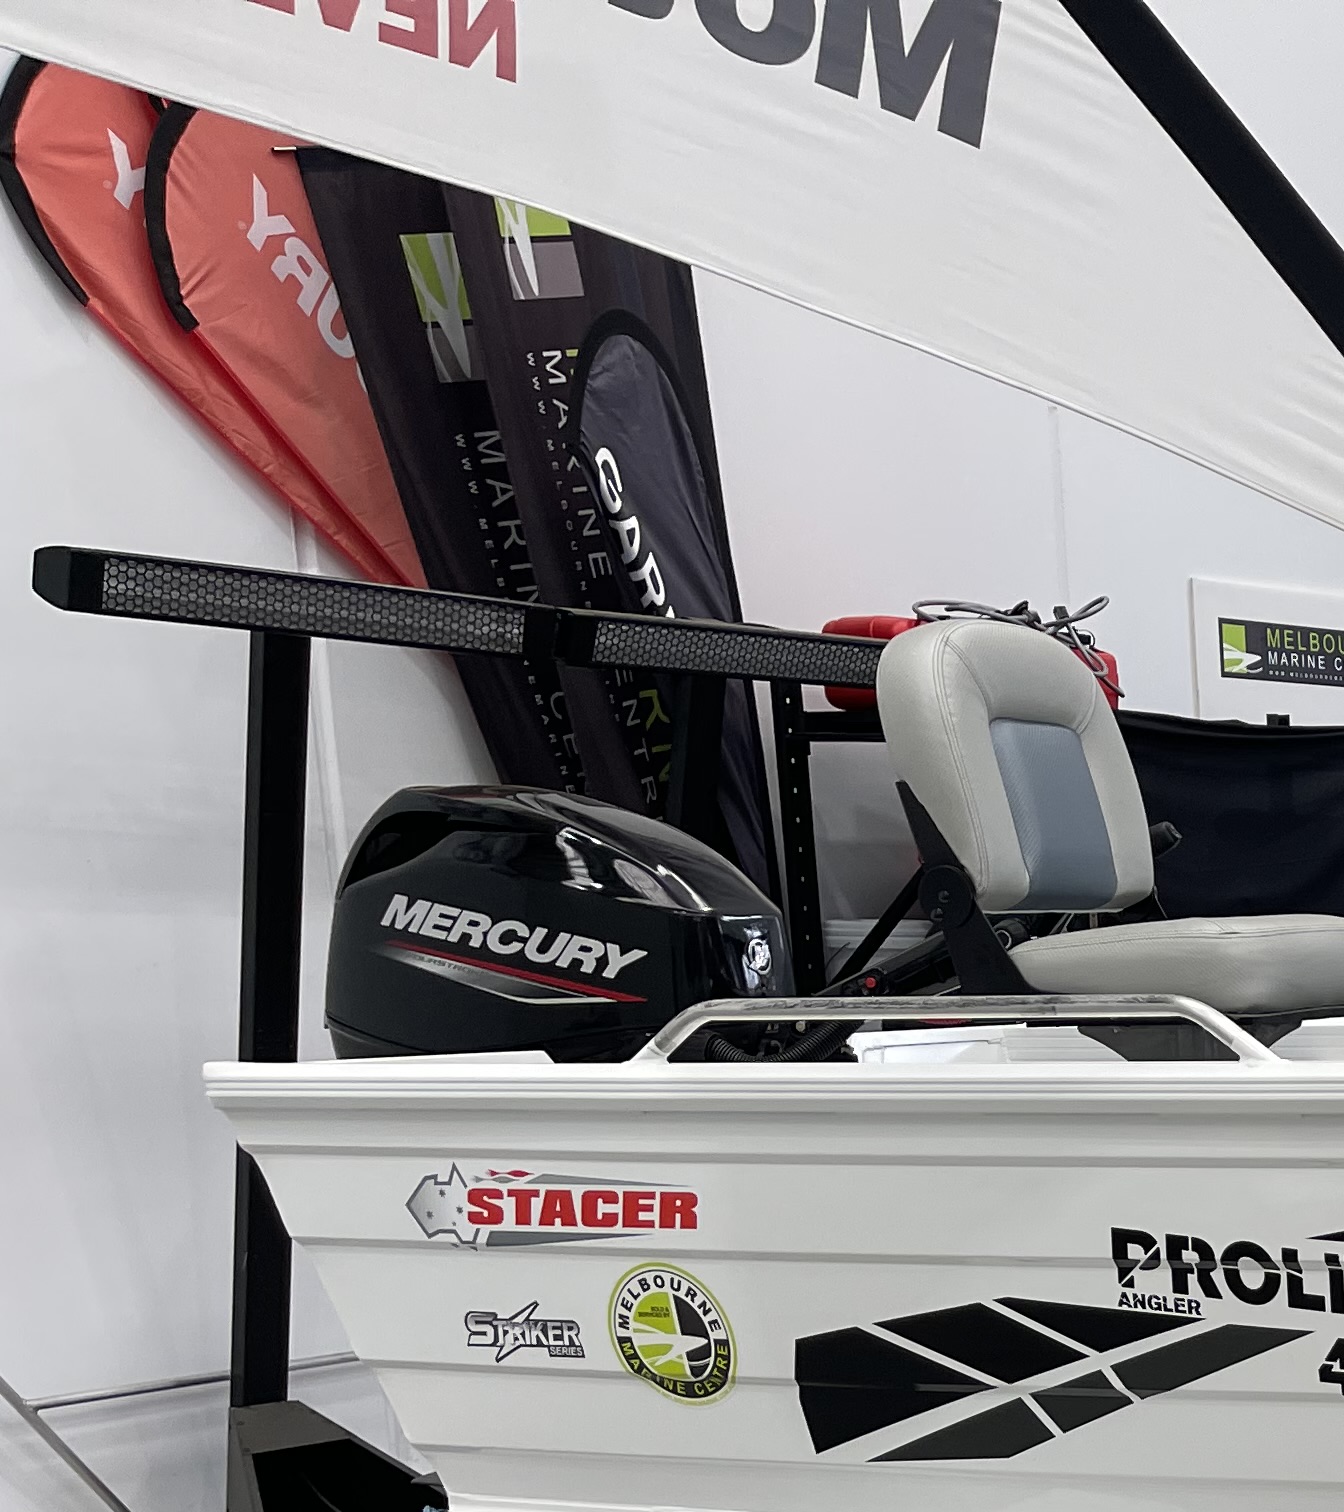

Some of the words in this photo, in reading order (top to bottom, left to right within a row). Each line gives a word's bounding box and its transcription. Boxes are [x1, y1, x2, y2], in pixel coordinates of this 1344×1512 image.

[473, 430, 540, 603] MARI
[595, 447, 675, 619] GAR
[1267, 651, 1326, 670] MARINE
[380, 893, 648, 979] MERCURY
[467, 1187, 699, 1230] STACER
[464, 1311, 582, 1348] STRIKER
[617, 1275, 722, 1332] MELBOURNE
[1117, 1291, 1202, 1317] ANGLER
[550, 1345, 583, 1357] SERIES
[621, 1342, 687, 1396] MARINE
[694, 1344, 728, 1396] CENTRE
